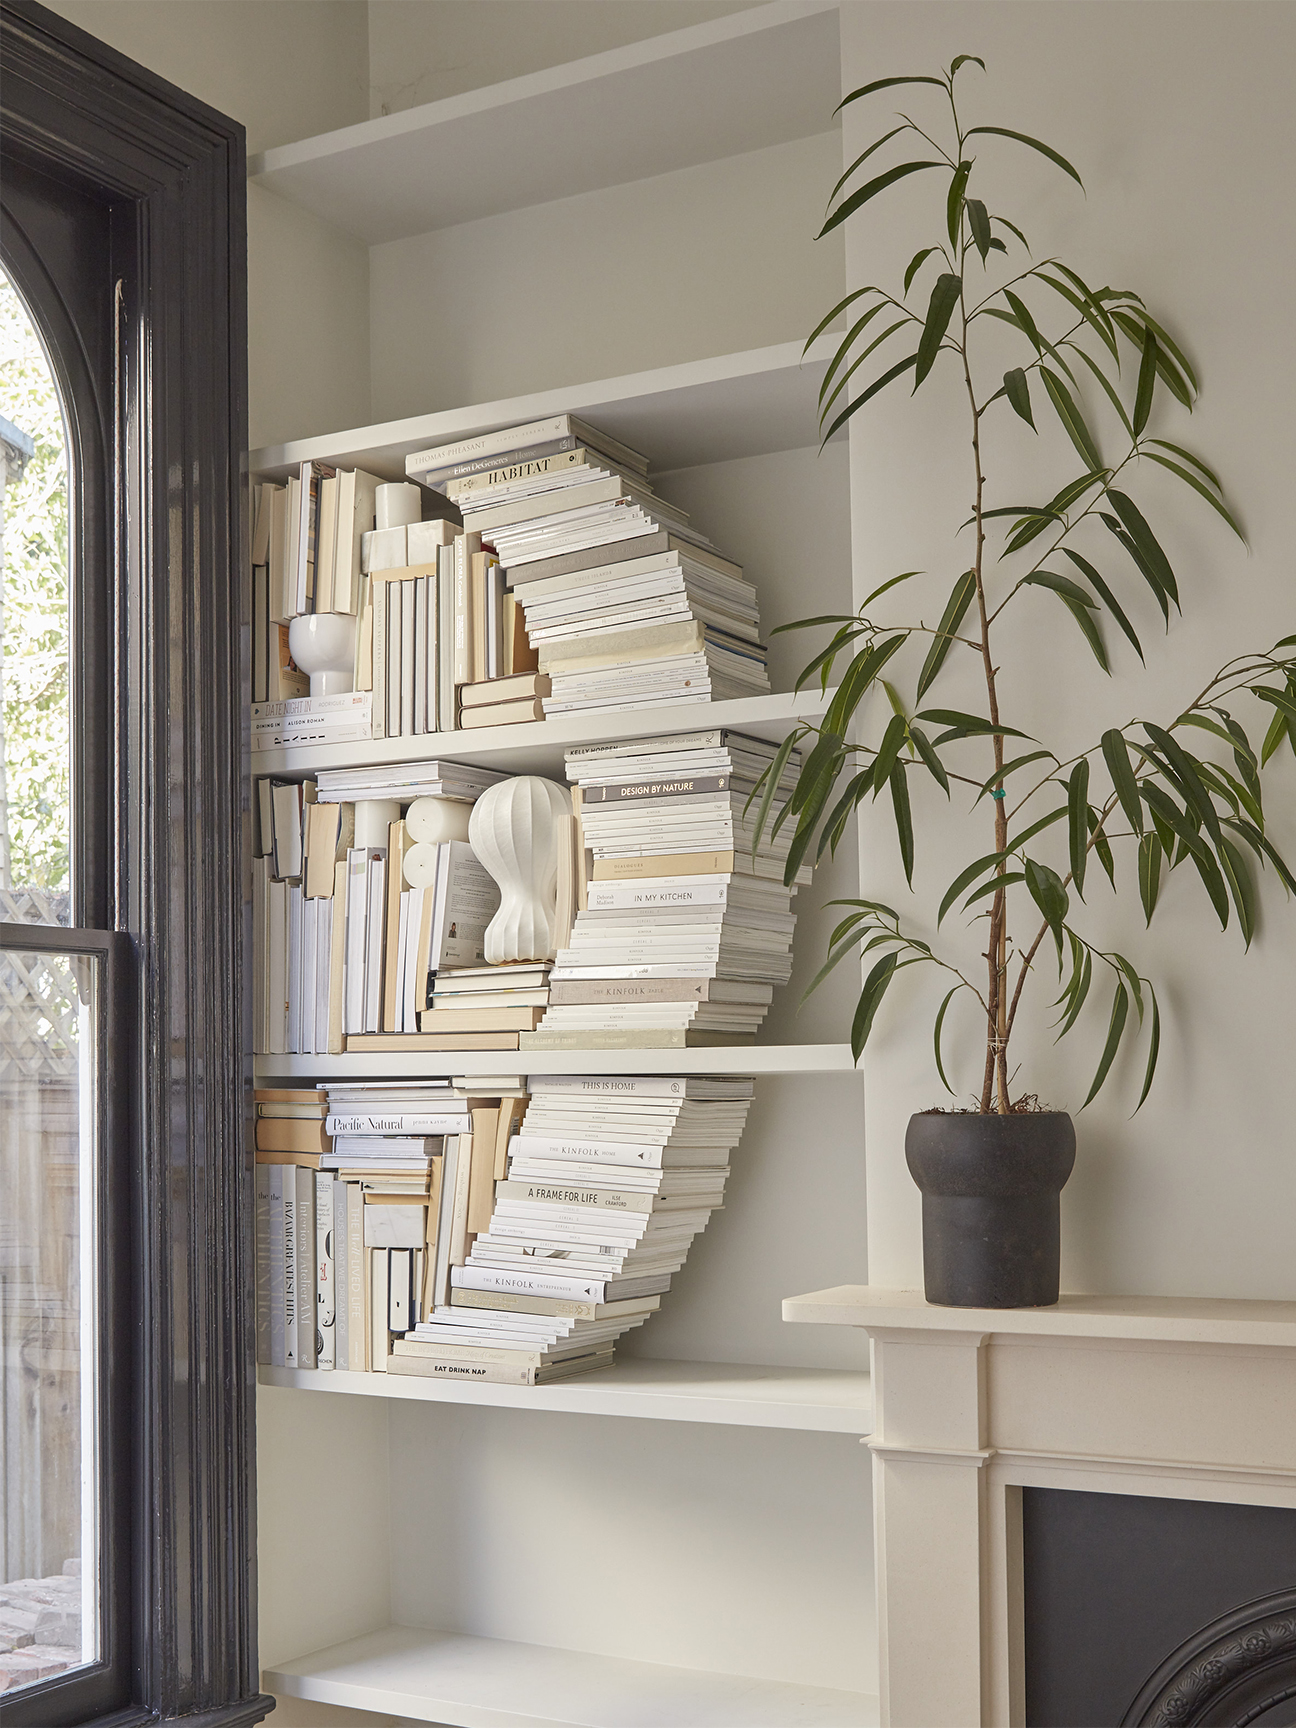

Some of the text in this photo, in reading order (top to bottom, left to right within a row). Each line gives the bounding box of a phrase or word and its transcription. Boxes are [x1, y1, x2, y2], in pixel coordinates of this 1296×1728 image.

[414, 452, 446, 465] THOMAS
[447, 441, 486, 456] PHEASANT
[454, 450, 536, 475] Ellen DeGeneres Home
[488, 458, 551, 484] HABITAT
[265, 703, 282, 716] DATE
[284, 701, 302, 715] NIGHT
[304, 700, 312, 712] IN
[570, 747, 590, 755] KELLY
[621, 782, 693, 796] DESIGN BY NATURE
[606, 987, 645, 996] KINFOLK
[611, 1082, 636, 1091] HOME
[334, 1117, 364, 1130] Pacific
[368, 1117, 403, 1130] Natural
[561, 1146, 599, 1156] KINFOLK
[528, 1188, 598, 1204] A FRAME FOR LIFE
[285, 1201, 293, 1238] BAZAAR
[351, 1207, 360, 1228] THE
[258, 1206, 270, 1332] AUTHENTICS
[270, 1207, 284, 1334] AUTHENTICS
[286, 1239, 294, 1297] GREATEST
[300, 1202, 311, 1324] Interiors Atelier AM
[338, 1267, 345, 1282] WE
[495, 1278, 534, 1288] KINFOLK
[352, 1298, 360, 1318] LIFE
[339, 1325, 346, 1336] OF
